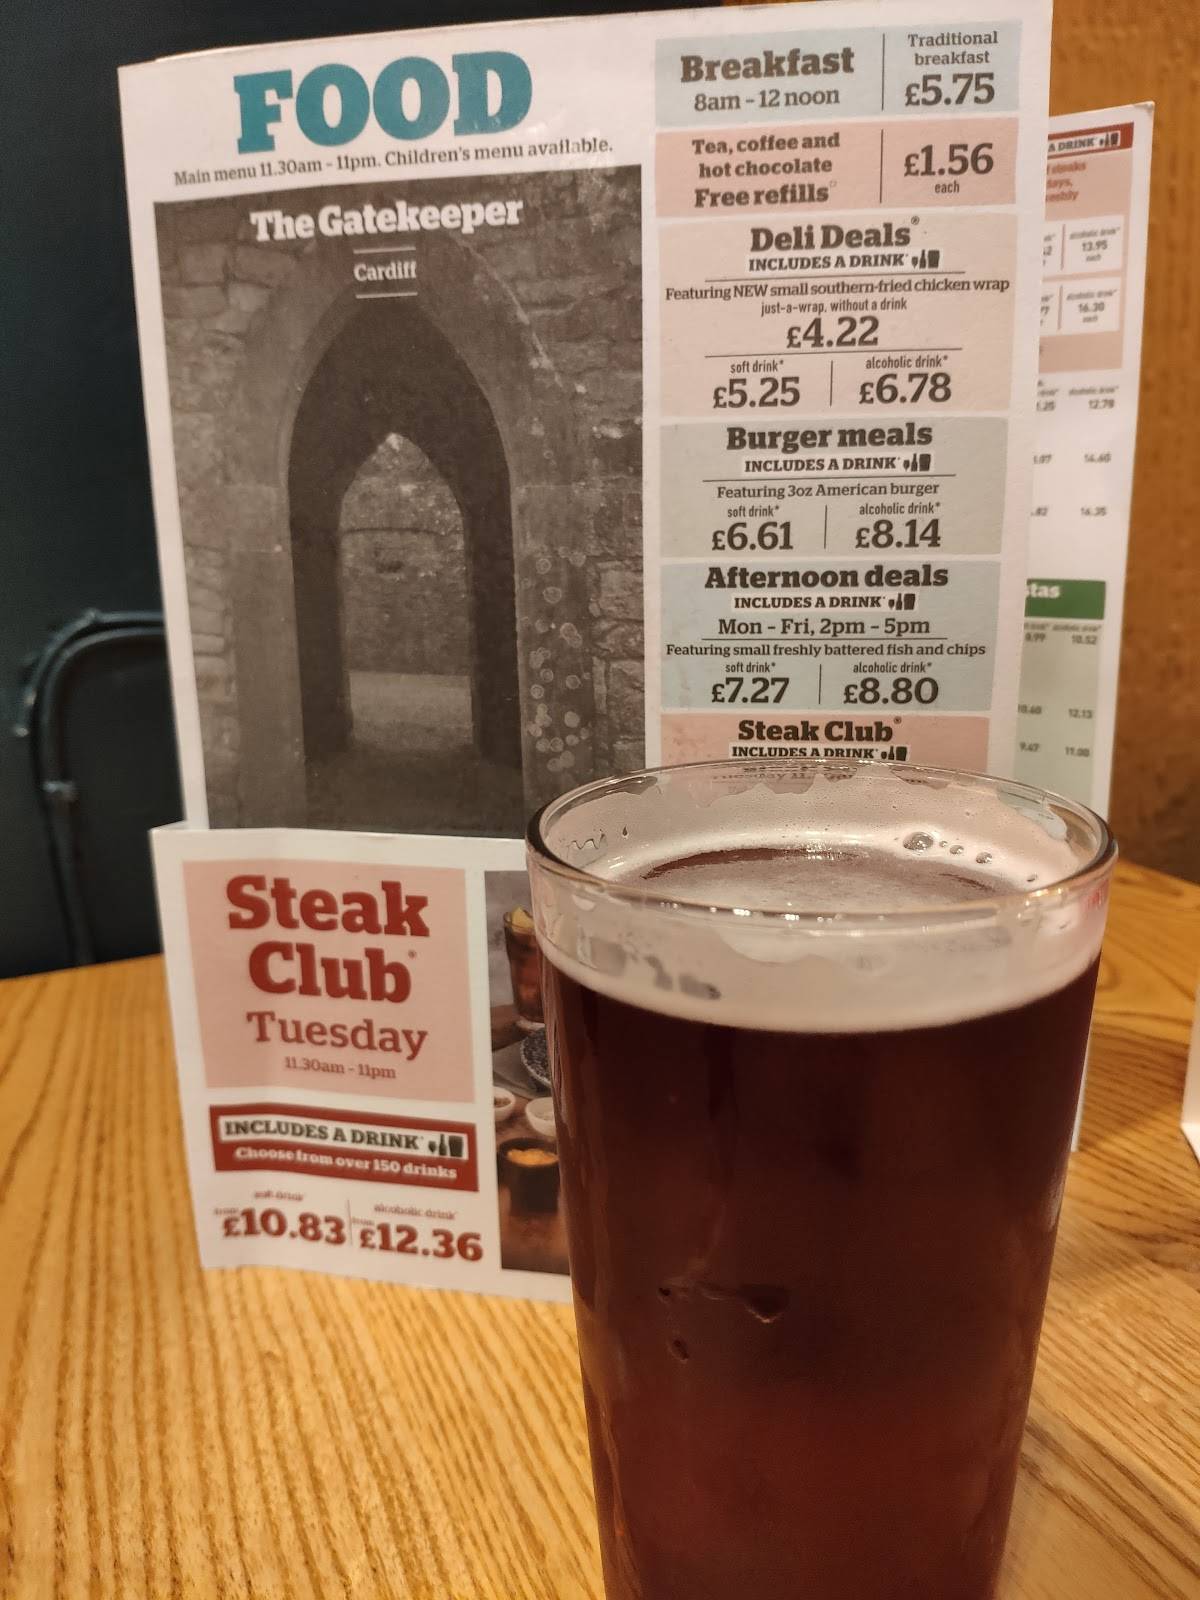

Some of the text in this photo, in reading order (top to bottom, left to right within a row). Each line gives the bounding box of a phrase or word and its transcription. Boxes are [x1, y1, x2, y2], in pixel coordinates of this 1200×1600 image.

[908, 31, 998, 48] Traditional
[681, 47, 854, 82] Breakfast
[915, 51, 989, 66] breakfast
[694, 92, 740, 112] 8am
[760, 90, 780, 108] 12
[784, 89, 840, 106] noon
[905, 72, 995, 107] £5.75
[233, 51, 532, 154] FOOD
[692, 132, 840, 156] Tea, coffee and
[174, 170, 209, 186] Main
[214, 165, 256, 181] menu
[260, 159, 322, 177] 11.30am
[337, 153, 380, 172] 11pm.
[386, 146, 470, 167] Children's
[475, 144, 524, 162] menu
[528, 136, 612, 156] available.
[699, 158, 832, 178] hot chocolate
[904, 143, 993, 177] £1.56
[695, 188, 750, 208] Free
[935, 180, 960, 194] each
[250, 197, 524, 242] The Gatekeeper
[751, 225, 814, 252] Deli
[354, 261, 416, 282] Cardiff
[749, 256, 831, 271] INCLUDES
[834, 256, 847, 268] A
[666, 278, 1010, 300] Featuring NEW small southern-fried chicken wrap
[830, 299, 868, 312] without
[871, 301, 878, 311] a
[880, 298, 907, 310] drink
[787, 316, 879, 349] £4.22
[731, 361, 750, 373] soft
[866, 357, 912, 370] alcoholic
[713, 377, 800, 409] £5.25
[859, 373, 952, 404] £6.78
[727, 422, 932, 454] Burger meals
[745, 459, 825, 473] INCLUDES
[828, 459, 839, 471] A
[717, 482, 939, 499] Featuring 3oz American burger
[728, 506, 746, 518] soft
[859, 504, 906, 515] alcoholic
[712, 521, 793, 551] £6.61
[856, 519, 941, 548] £8.14
[705, 564, 948, 589] Afternoon deals
[735, 597, 812, 609] INCLUDES
[815, 596, 826, 608] A
[718, 619, 762, 634] Mon
[781, 619, 814, 636] Fri,
[821, 619, 865, 638] 2pm
[884, 619, 930, 637] 5pm
[666, 643, 986, 657] Featuring small freshly battered fish and chips
[726, 662, 744, 673] soft
[853, 662, 898, 672] alcoholic
[712, 678, 789, 704] £7.27
[843, 677, 939, 705] £8.80
[738, 720, 819, 742] Steak
[732, 746, 807, 758] INCLUDES
[810, 747, 821, 757] A
[226, 875, 430, 937] Steak
[246, 1010, 428, 1061] Tuesday
[285, 1056, 345, 1074] 11.30am
[358, 1063, 396, 1079] 11pm
[225, 1120, 328, 1142] INCLUDES
[332, 1129, 348, 1142] A
[235, 1147, 457, 1179] Choose from over 150 drinks
[223, 1207, 346, 1245] £10.83
[360, 1223, 483, 1262] £12.36
